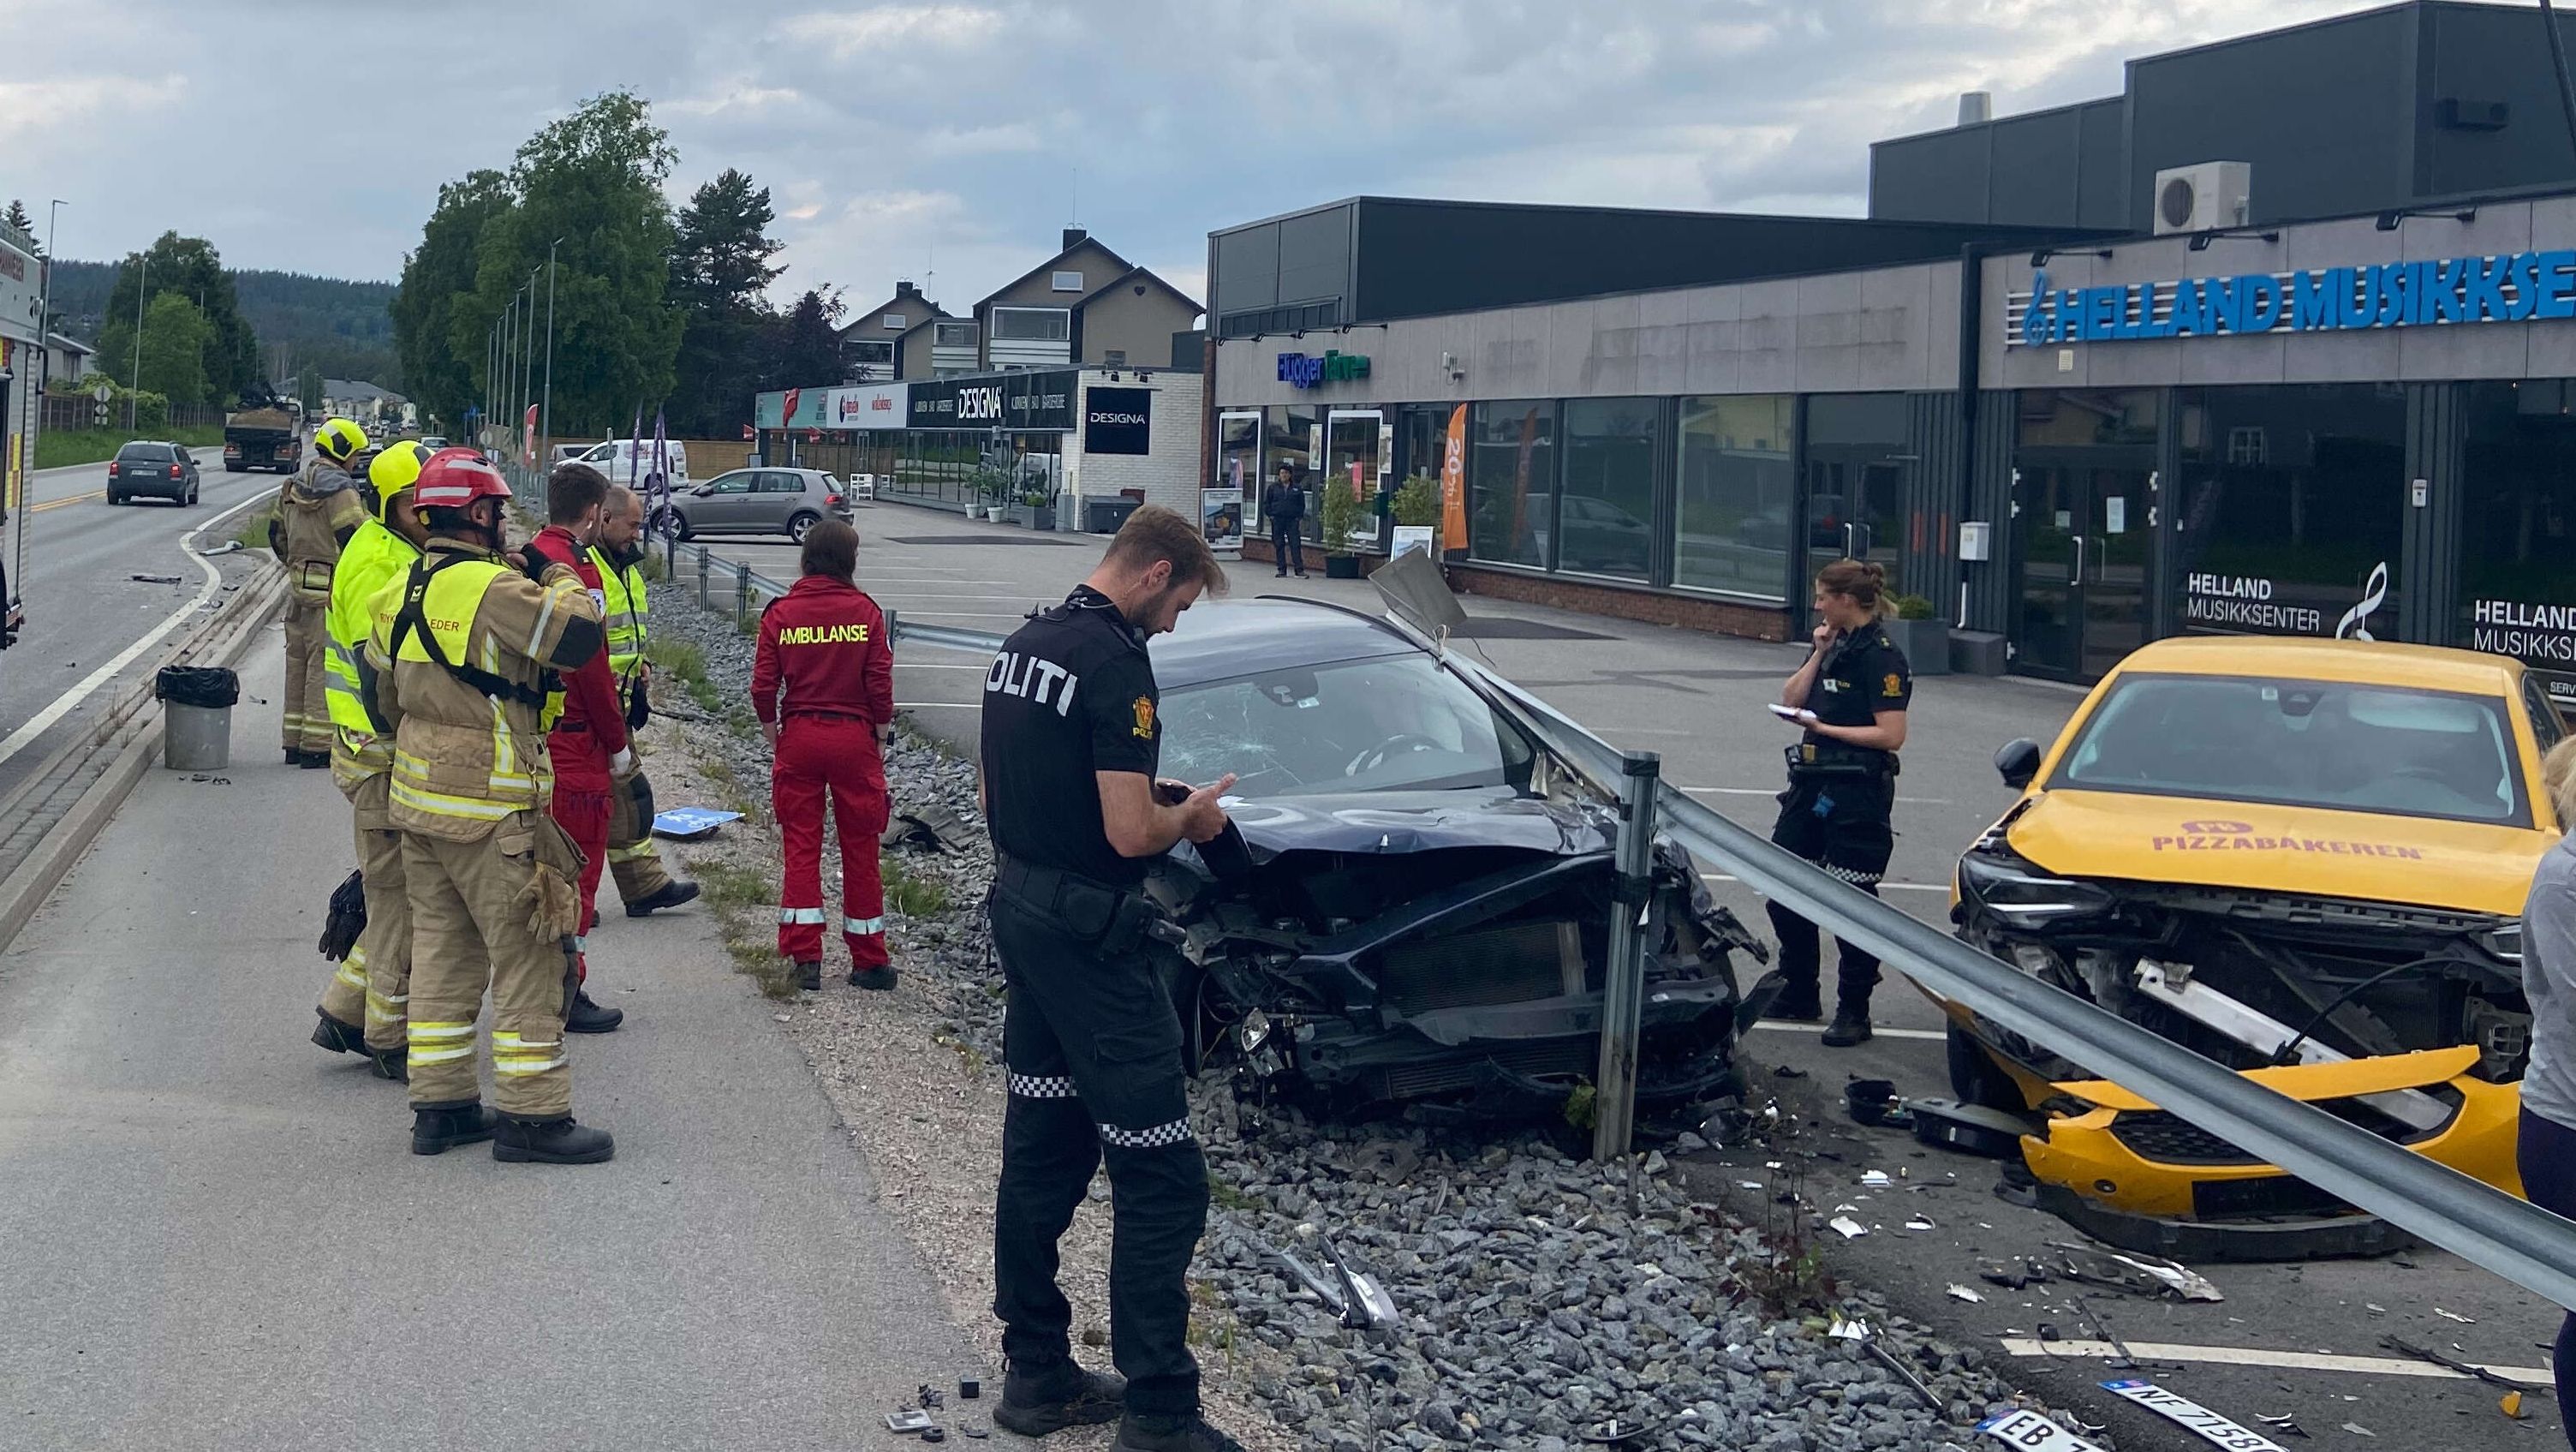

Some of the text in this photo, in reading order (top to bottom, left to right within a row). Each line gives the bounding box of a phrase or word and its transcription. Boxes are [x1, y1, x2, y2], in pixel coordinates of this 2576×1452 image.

[2055, 250, 2576, 341] HELLAND MUSIKKSE
[958, 385, 1003, 419] DESIGNA
[1090, 412, 1146, 425] DESIGNA
[2189, 572, 2272, 600] HELLAND
[431, 618, 460, 631] EDER
[2187, 597, 2320, 632] MUSIKKSENTER
[779, 624, 868, 645] AMBULANSE
[2474, 627, 2576, 661] MUSIKKS
[986, 651, 1078, 717] OLITI
[2152, 835, 2424, 860] PIZZABAKEREN
[2001, 1415, 2054, 1446] EB
[2131, 1389, 2280, 1452] NF 7158
